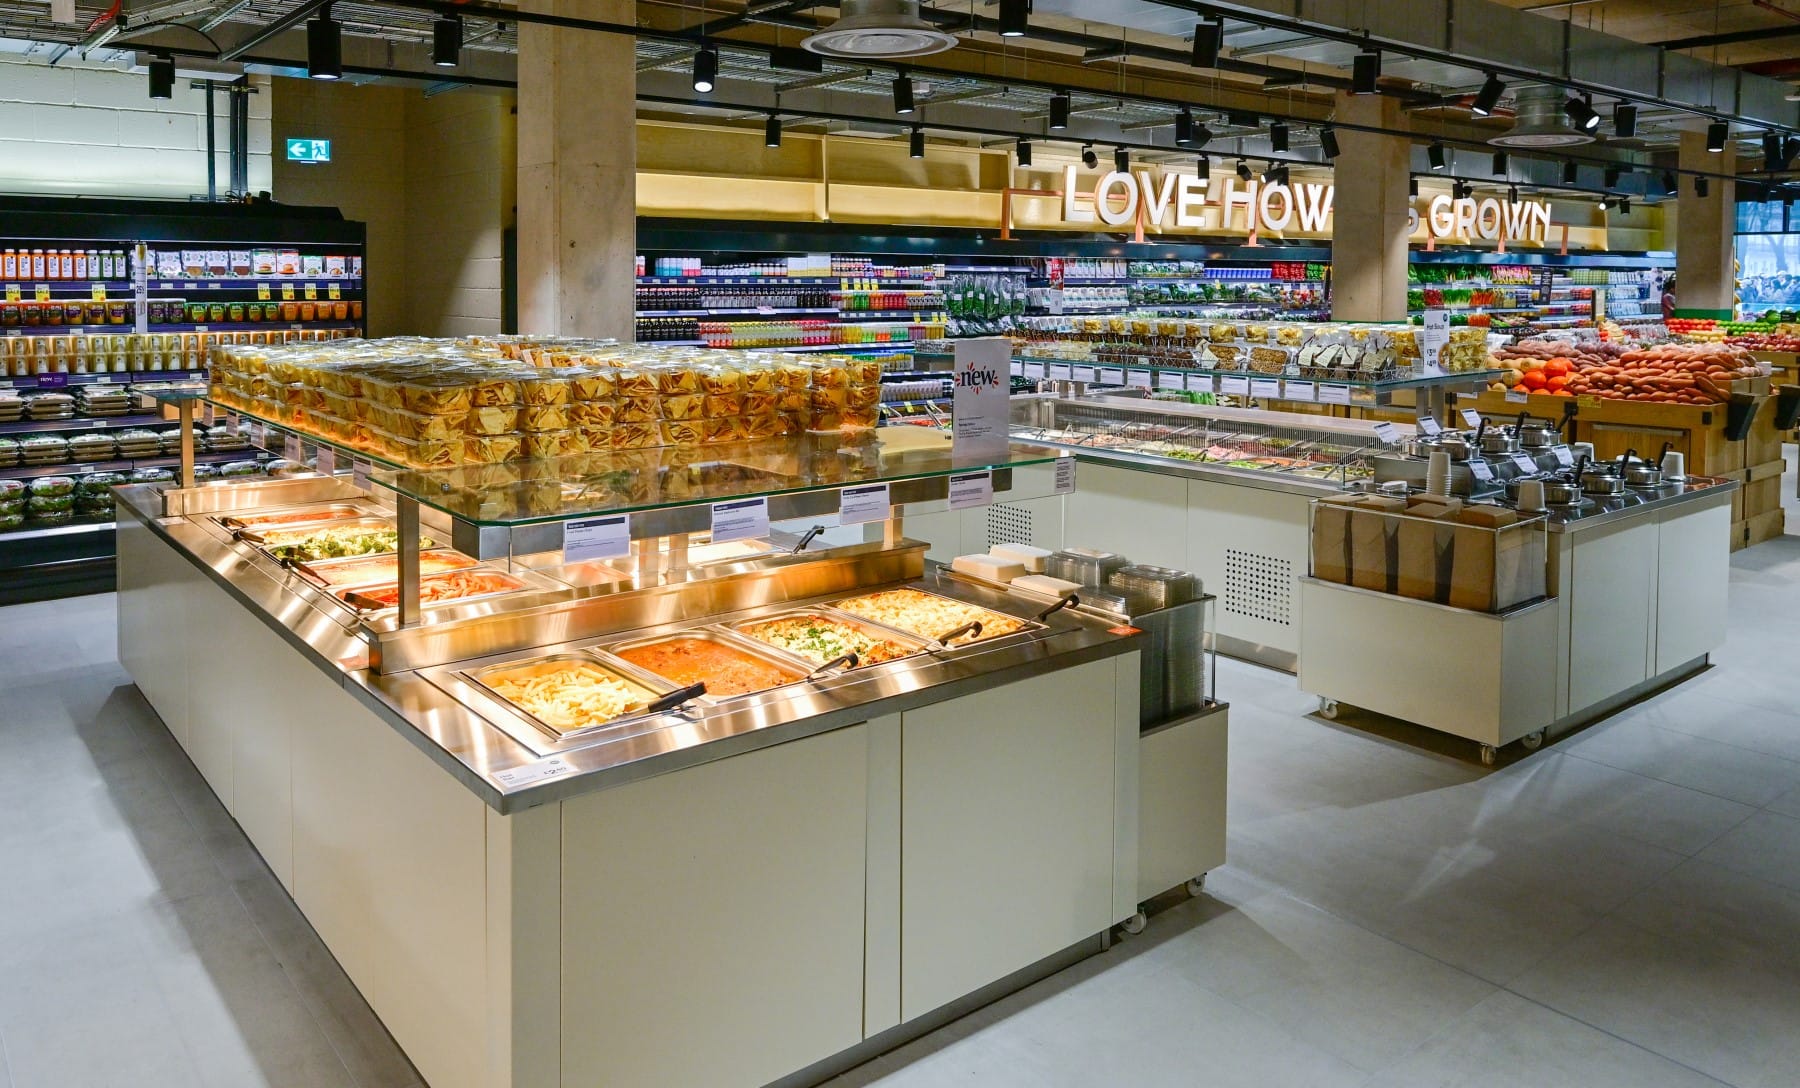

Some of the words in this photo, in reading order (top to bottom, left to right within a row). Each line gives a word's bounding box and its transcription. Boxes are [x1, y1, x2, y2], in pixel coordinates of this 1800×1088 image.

[1062, 165, 1208, 225] LOVE
[1222, 177, 1334, 232] HOW
[1430, 194, 1552, 240] GROWN
[960, 370, 996, 387] new
